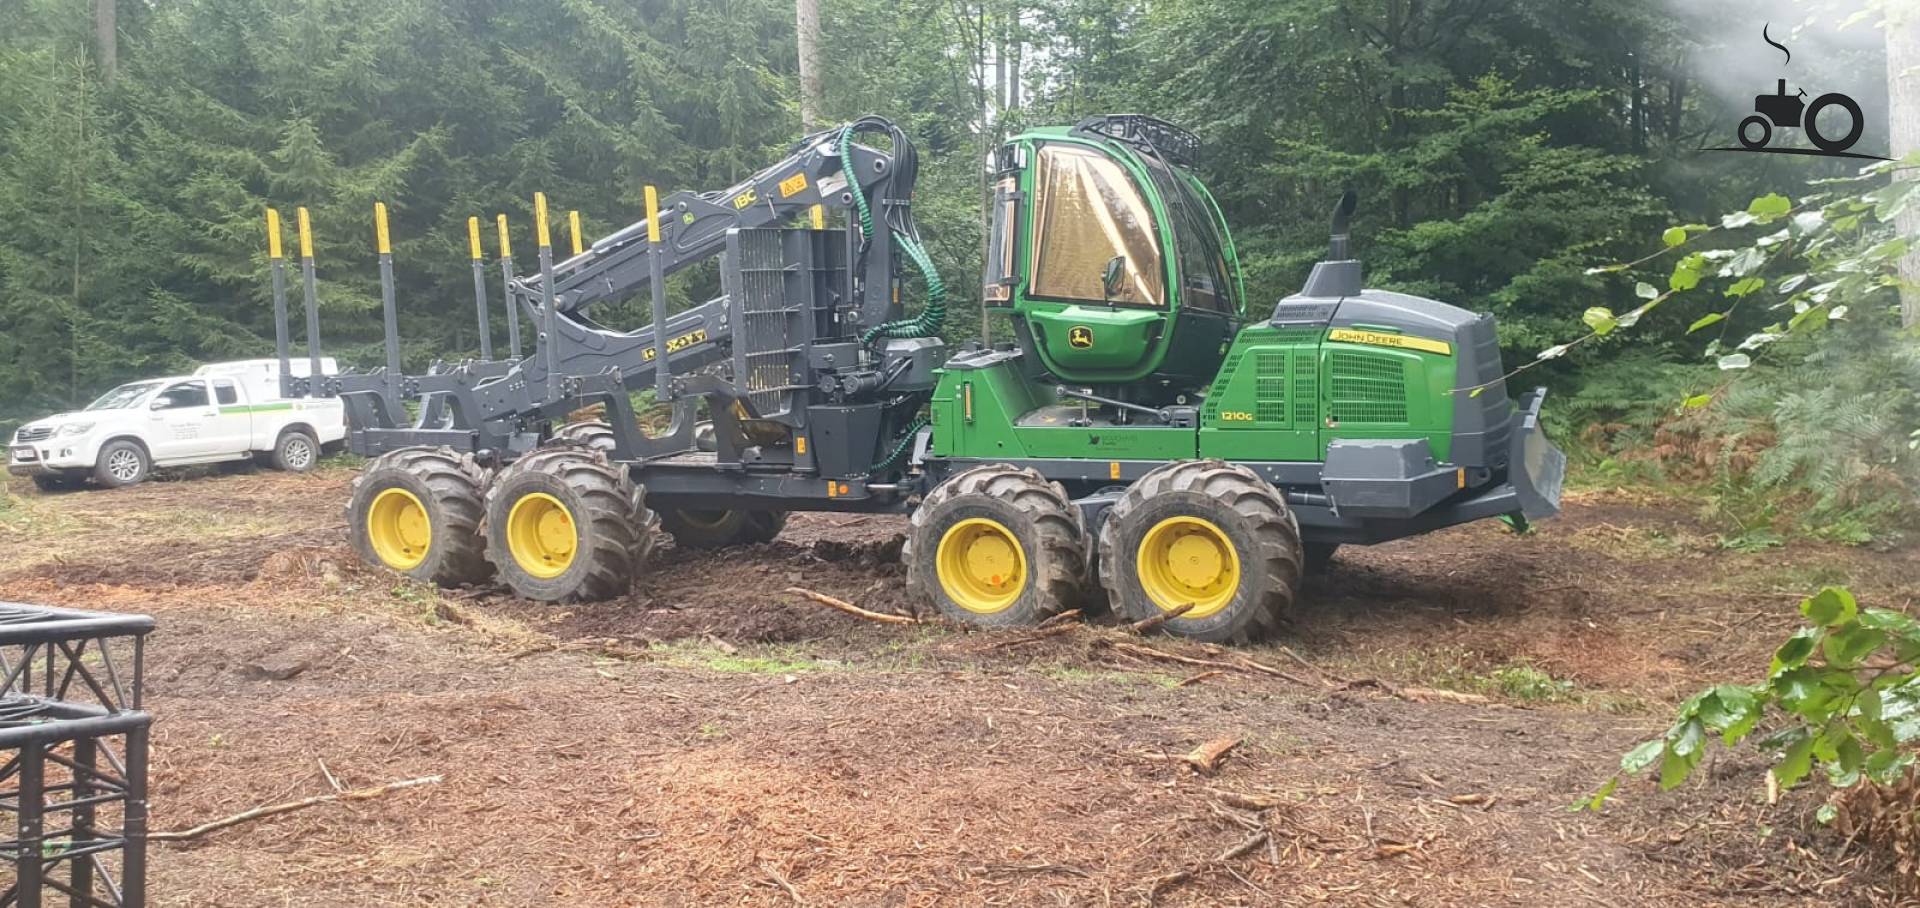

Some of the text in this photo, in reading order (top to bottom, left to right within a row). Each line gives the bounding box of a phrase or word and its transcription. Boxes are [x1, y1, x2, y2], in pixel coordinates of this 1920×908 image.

[733, 189, 757, 210] IBC
[1335, 330, 1404, 346] JOHN DEERE
[1221, 411, 1253, 421] 1210G
